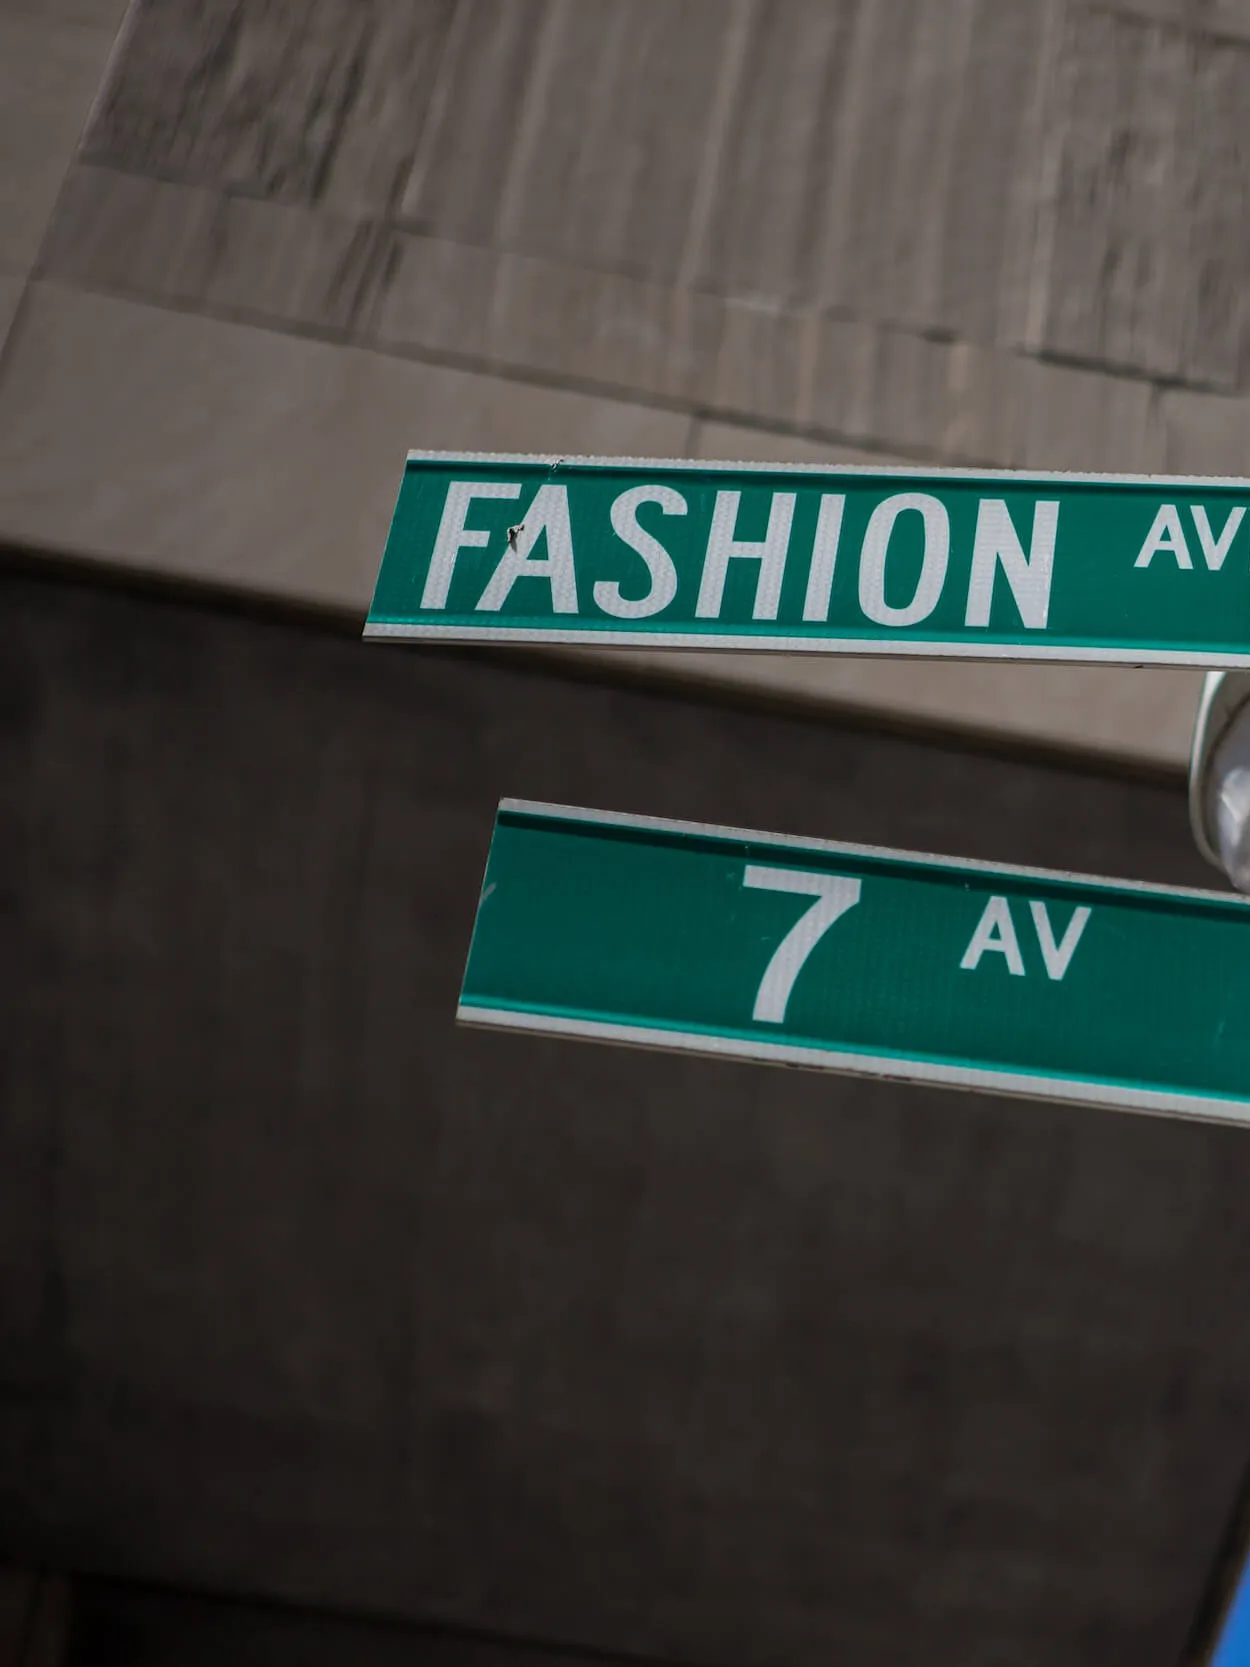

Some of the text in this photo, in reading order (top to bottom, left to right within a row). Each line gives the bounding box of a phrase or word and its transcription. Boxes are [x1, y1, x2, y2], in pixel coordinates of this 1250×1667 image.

[420, 480, 1060, 630] FASHION
[742, 864, 1091, 1024] 7 AV
